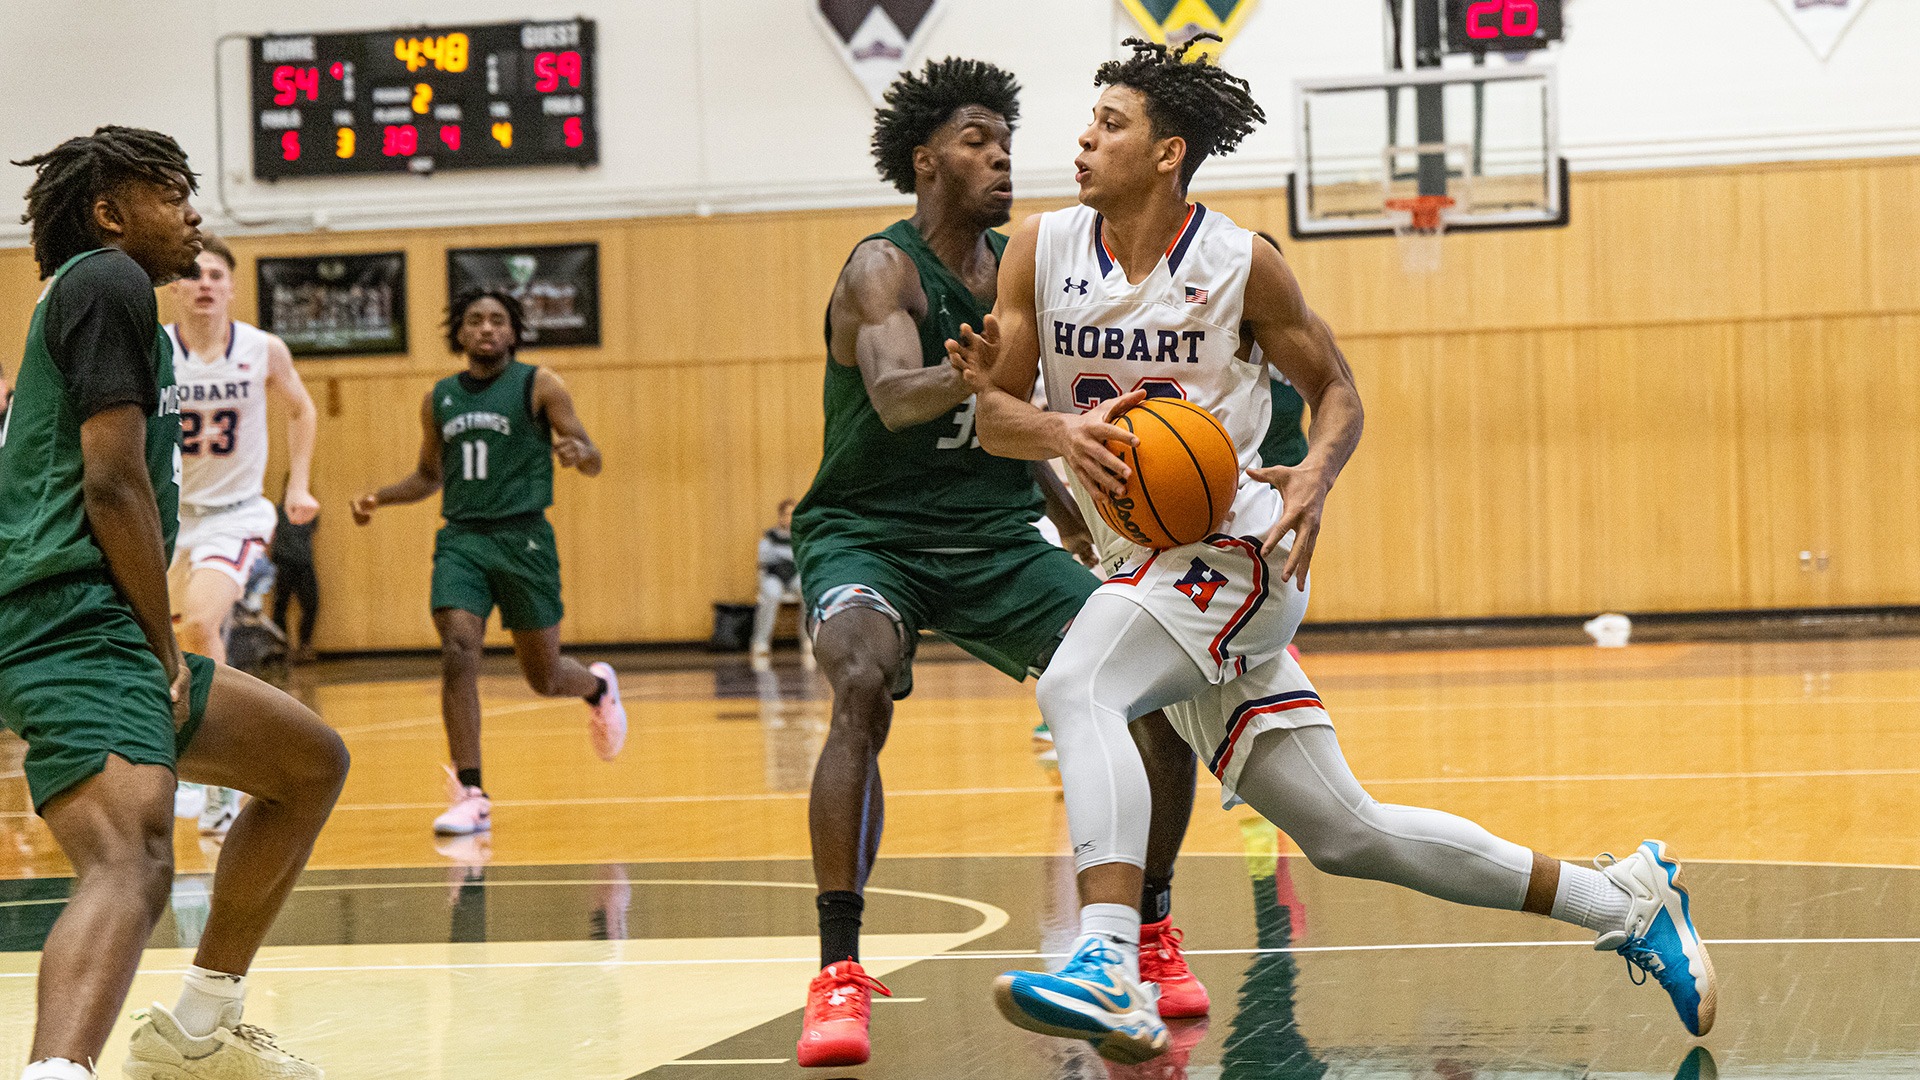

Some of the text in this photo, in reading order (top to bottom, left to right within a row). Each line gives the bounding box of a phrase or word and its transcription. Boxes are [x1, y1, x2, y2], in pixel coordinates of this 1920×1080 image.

[394, 33, 469, 73] 4:48
[533, 51, 581, 93] 59
[272, 65, 319, 106] 54
[411, 83, 433, 115] 2
[281, 131, 300, 161] 5
[336, 127, 356, 159] 3
[563, 117, 583, 148] 5
[1054, 320, 1205, 363] HOBART
[178, 381, 249, 401] OBART
[180, 408, 239, 456] 23
[936, 392, 981, 449] 3
[462, 439, 488, 480] 11
